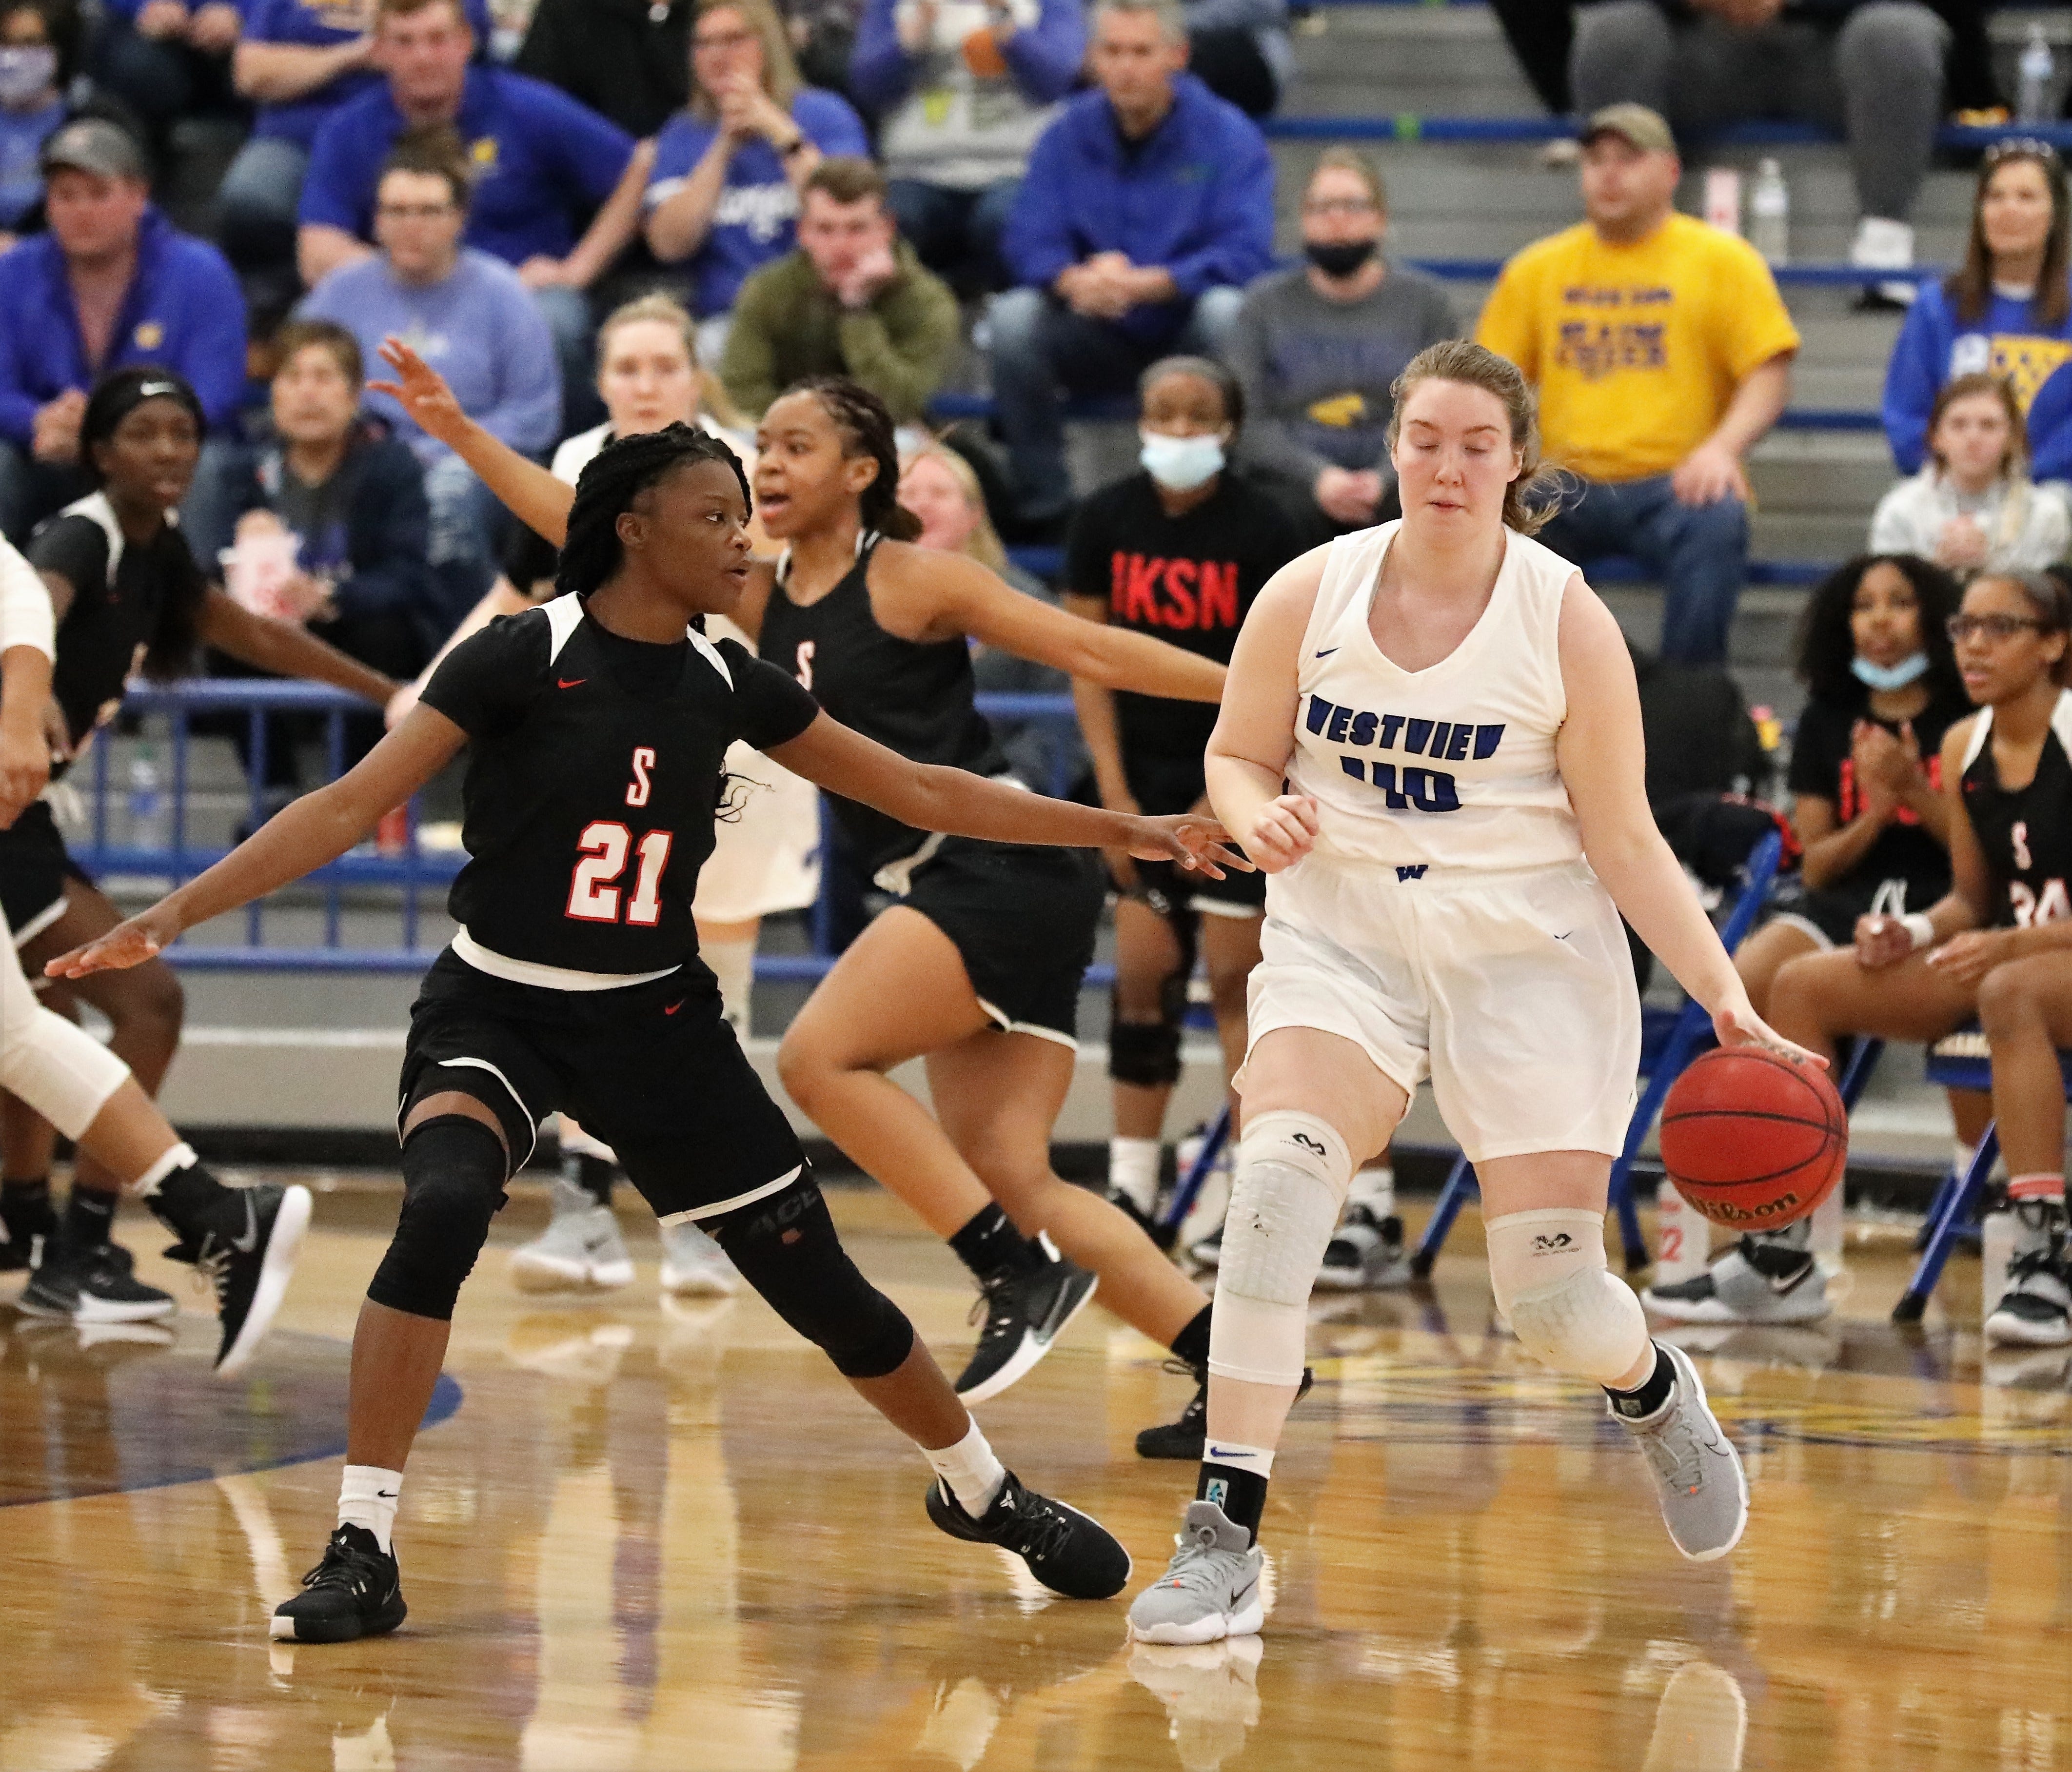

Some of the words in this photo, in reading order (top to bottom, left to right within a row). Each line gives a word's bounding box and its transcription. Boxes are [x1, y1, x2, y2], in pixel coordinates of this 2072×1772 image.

[796, 639, 816, 691] S
[1306, 694, 1506, 760] WESTVIEW
[626, 747, 655, 807] S
[564, 820, 673, 926] 21
[1395, 864, 1429, 883] W
